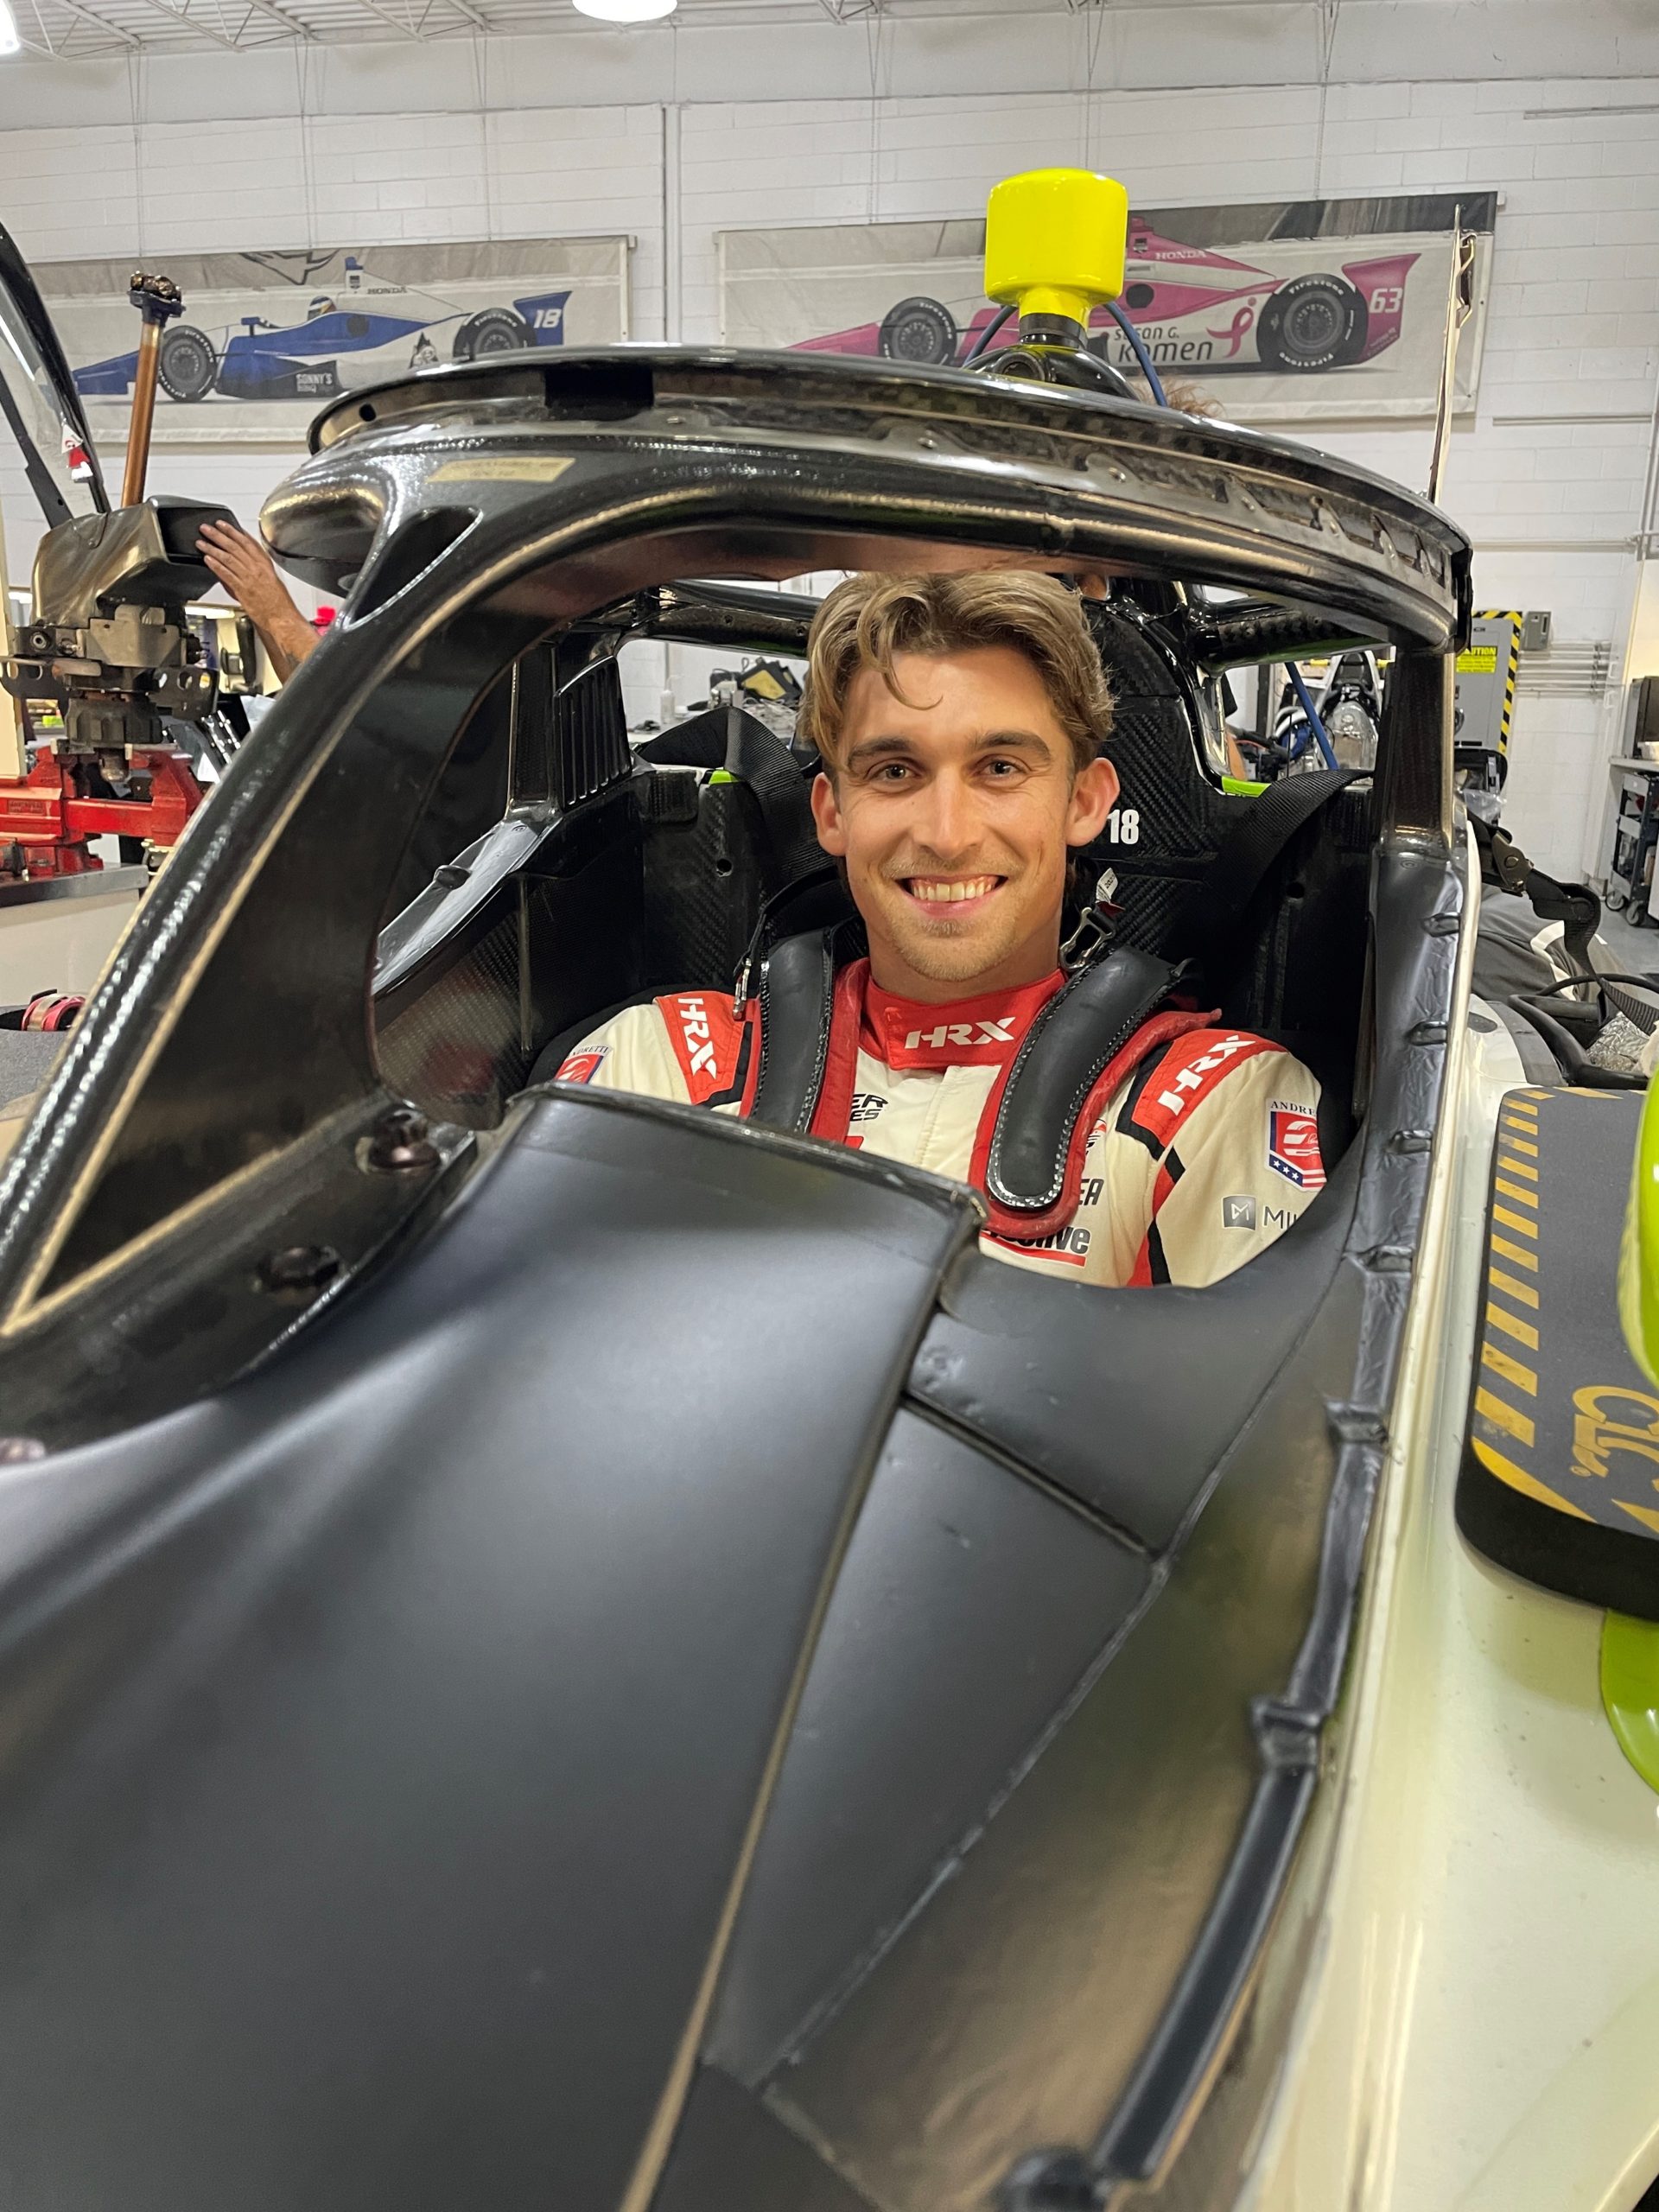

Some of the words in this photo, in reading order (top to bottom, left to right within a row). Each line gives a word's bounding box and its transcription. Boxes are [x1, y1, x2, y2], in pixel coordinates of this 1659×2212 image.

[1155, 250, 1207, 260] HONDA
[366, 286, 408, 295] HONDA
[1369, 287, 1403, 314] 63
[533, 308, 563, 328] 18
[1106, 809, 1140, 845] 18
[677, 998, 717, 1080] HRX
[905, 1016, 1016, 1049] HRX
[1157, 1034, 1256, 1117] HRX
